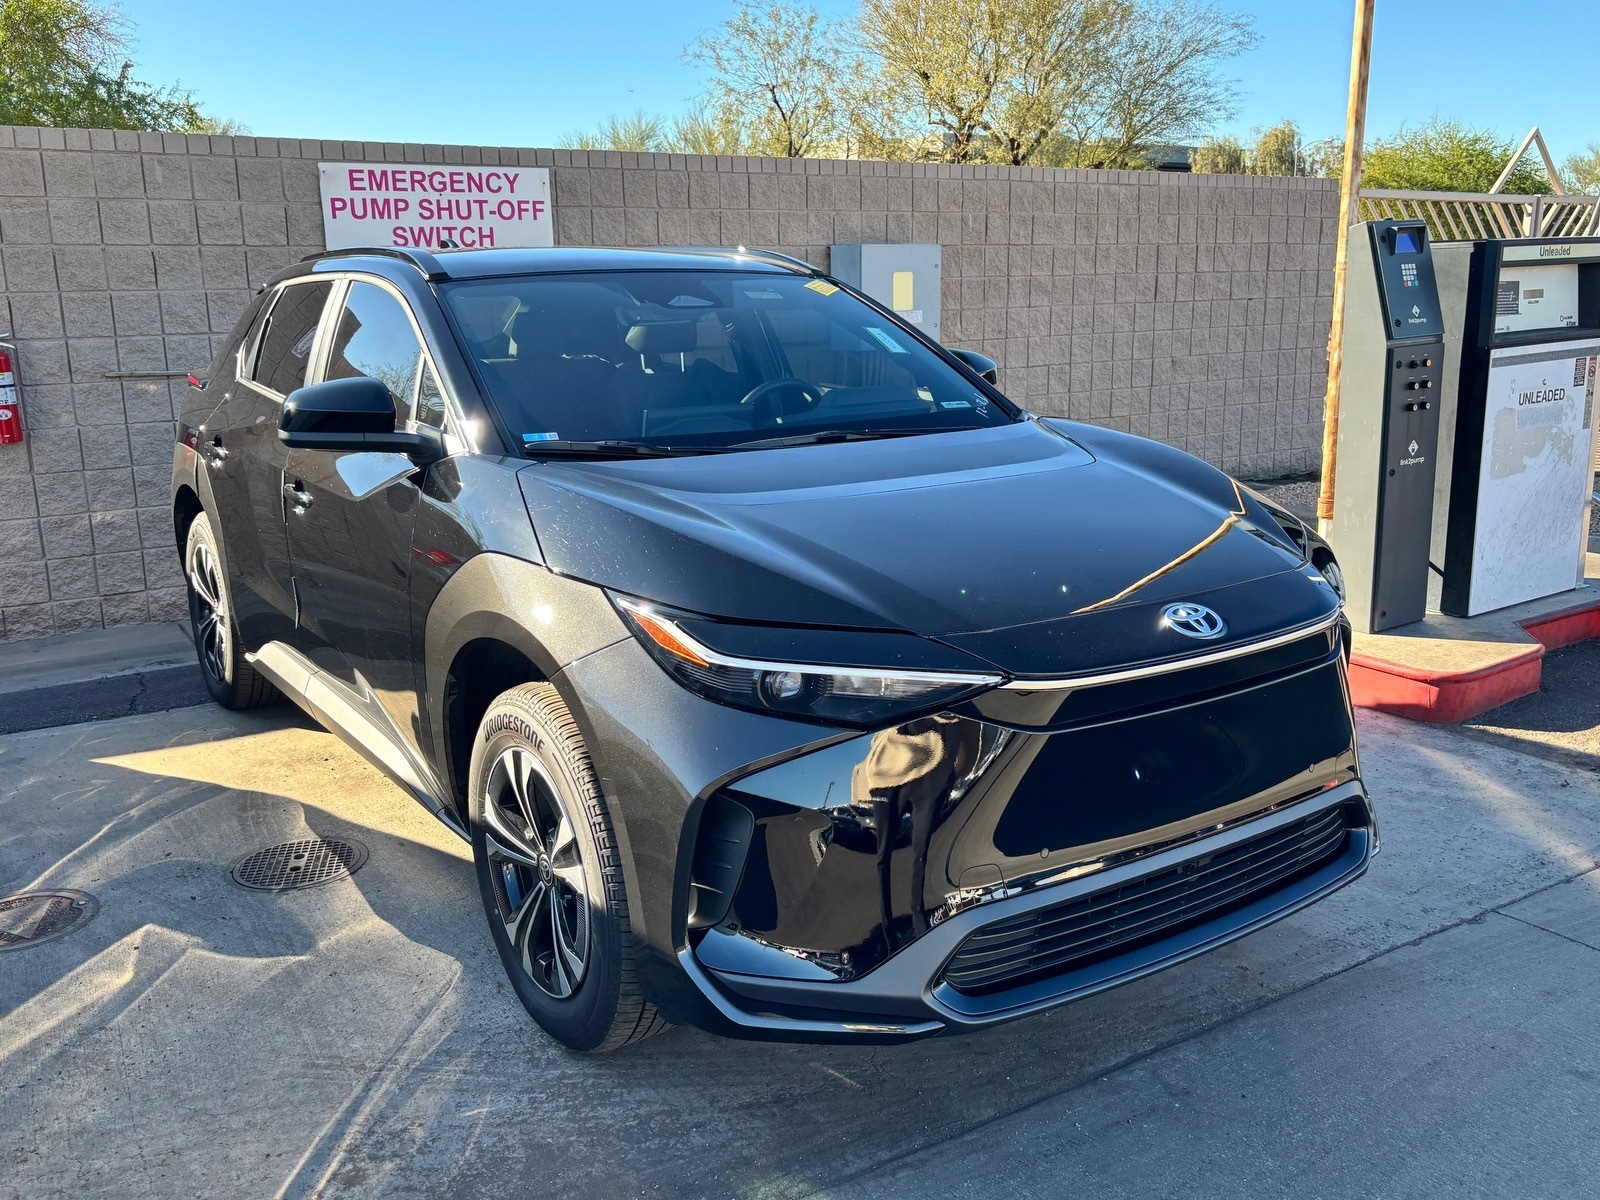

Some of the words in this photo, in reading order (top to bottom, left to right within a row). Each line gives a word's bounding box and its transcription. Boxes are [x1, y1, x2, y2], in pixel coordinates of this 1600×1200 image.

[348, 169, 519, 194] EMERGENCY
[330, 197, 410, 220] PUMP
[418, 199, 545, 221] SHUT-OFF
[392, 226, 495, 248] SWITCH
[1539, 245, 1571, 257] Unleaded
[1518, 388, 1566, 406] UNLEADED
[483, 713, 545, 756] BRIDGESTONE
